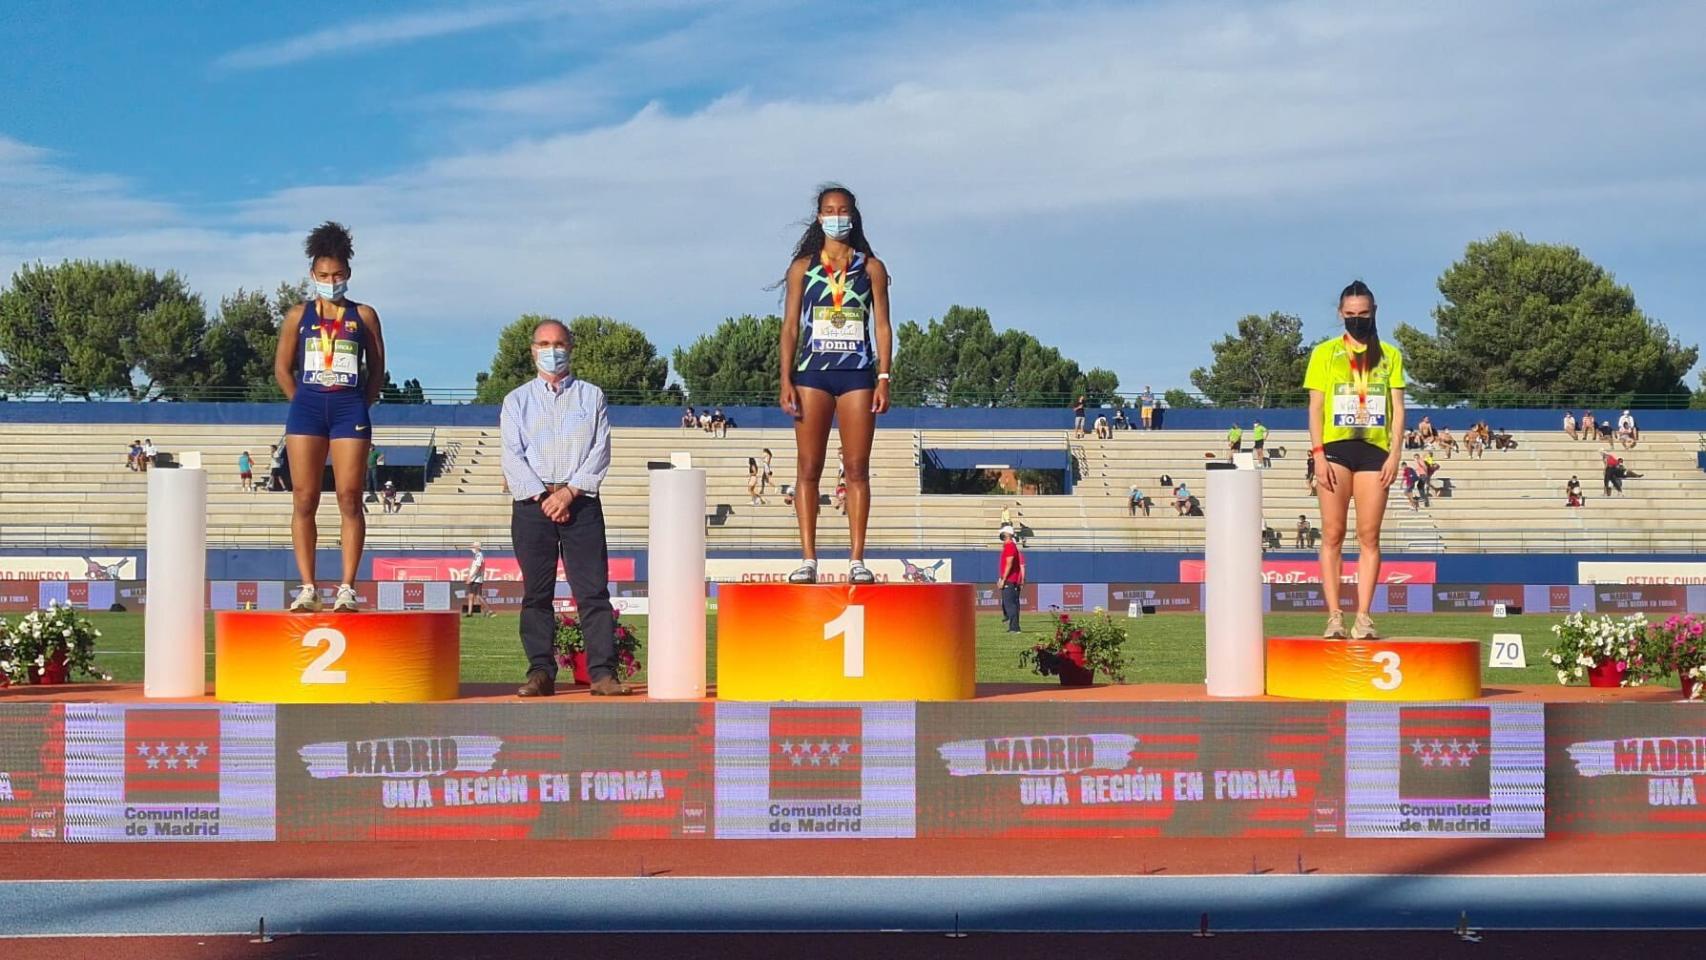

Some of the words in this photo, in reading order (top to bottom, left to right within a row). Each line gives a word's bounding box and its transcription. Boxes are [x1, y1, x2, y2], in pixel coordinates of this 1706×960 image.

[824, 605, 865, 677] 1
[1495, 642, 1519, 660] 70
[301, 627, 347, 684] 2
[1371, 651, 1403, 690] 3
[346, 737, 458, 775] MADRID
[985, 736, 1094, 772] MADRID
[382, 779, 433, 808] UNA
[444, 768, 527, 807] REGIÓN
[539, 774, 570, 802] EN
[581, 770, 665, 801] FORMA
[1020, 777, 1069, 806] UNA
[1081, 767, 1162, 804] REGIÓN
[1174, 772, 1204, 800] EN
[1214, 769, 1298, 799] FORMA
[1648, 778, 1697, 806] UNA
[124, 807, 220, 821] Comunidad
[769, 804, 862, 818] Comunidad
[1400, 803, 1492, 817] Comunidad
[125, 821, 150, 836] de
[154, 821, 220, 836] Madrid
[769, 818, 793, 832] de
[798, 818, 862, 832] Madrid
[1400, 817, 1423, 832] de
[1428, 817, 1491, 832] Madrid
